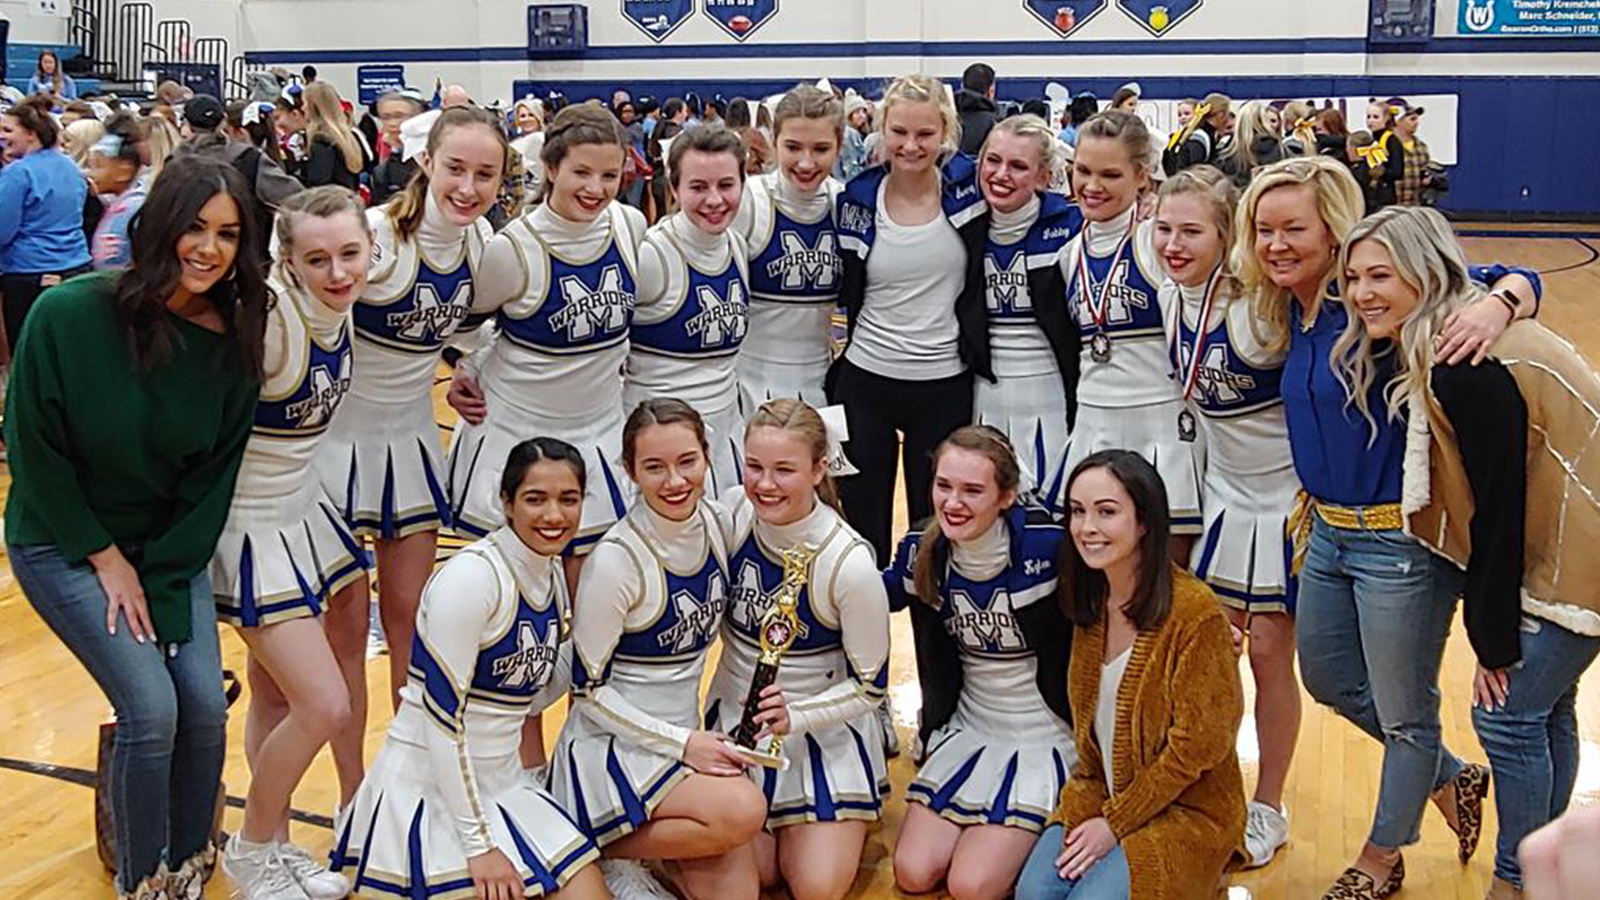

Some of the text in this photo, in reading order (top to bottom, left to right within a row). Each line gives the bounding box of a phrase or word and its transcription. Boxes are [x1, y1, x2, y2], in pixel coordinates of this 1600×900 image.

[1519, 11, 1543, 20] Marc
[986, 272, 1026, 287] RRIO
[560, 262, 628, 342] M
[685, 301, 749, 337] WARRIO
[657, 599, 723, 647] WARRIO
[950, 587, 1027, 651] M
